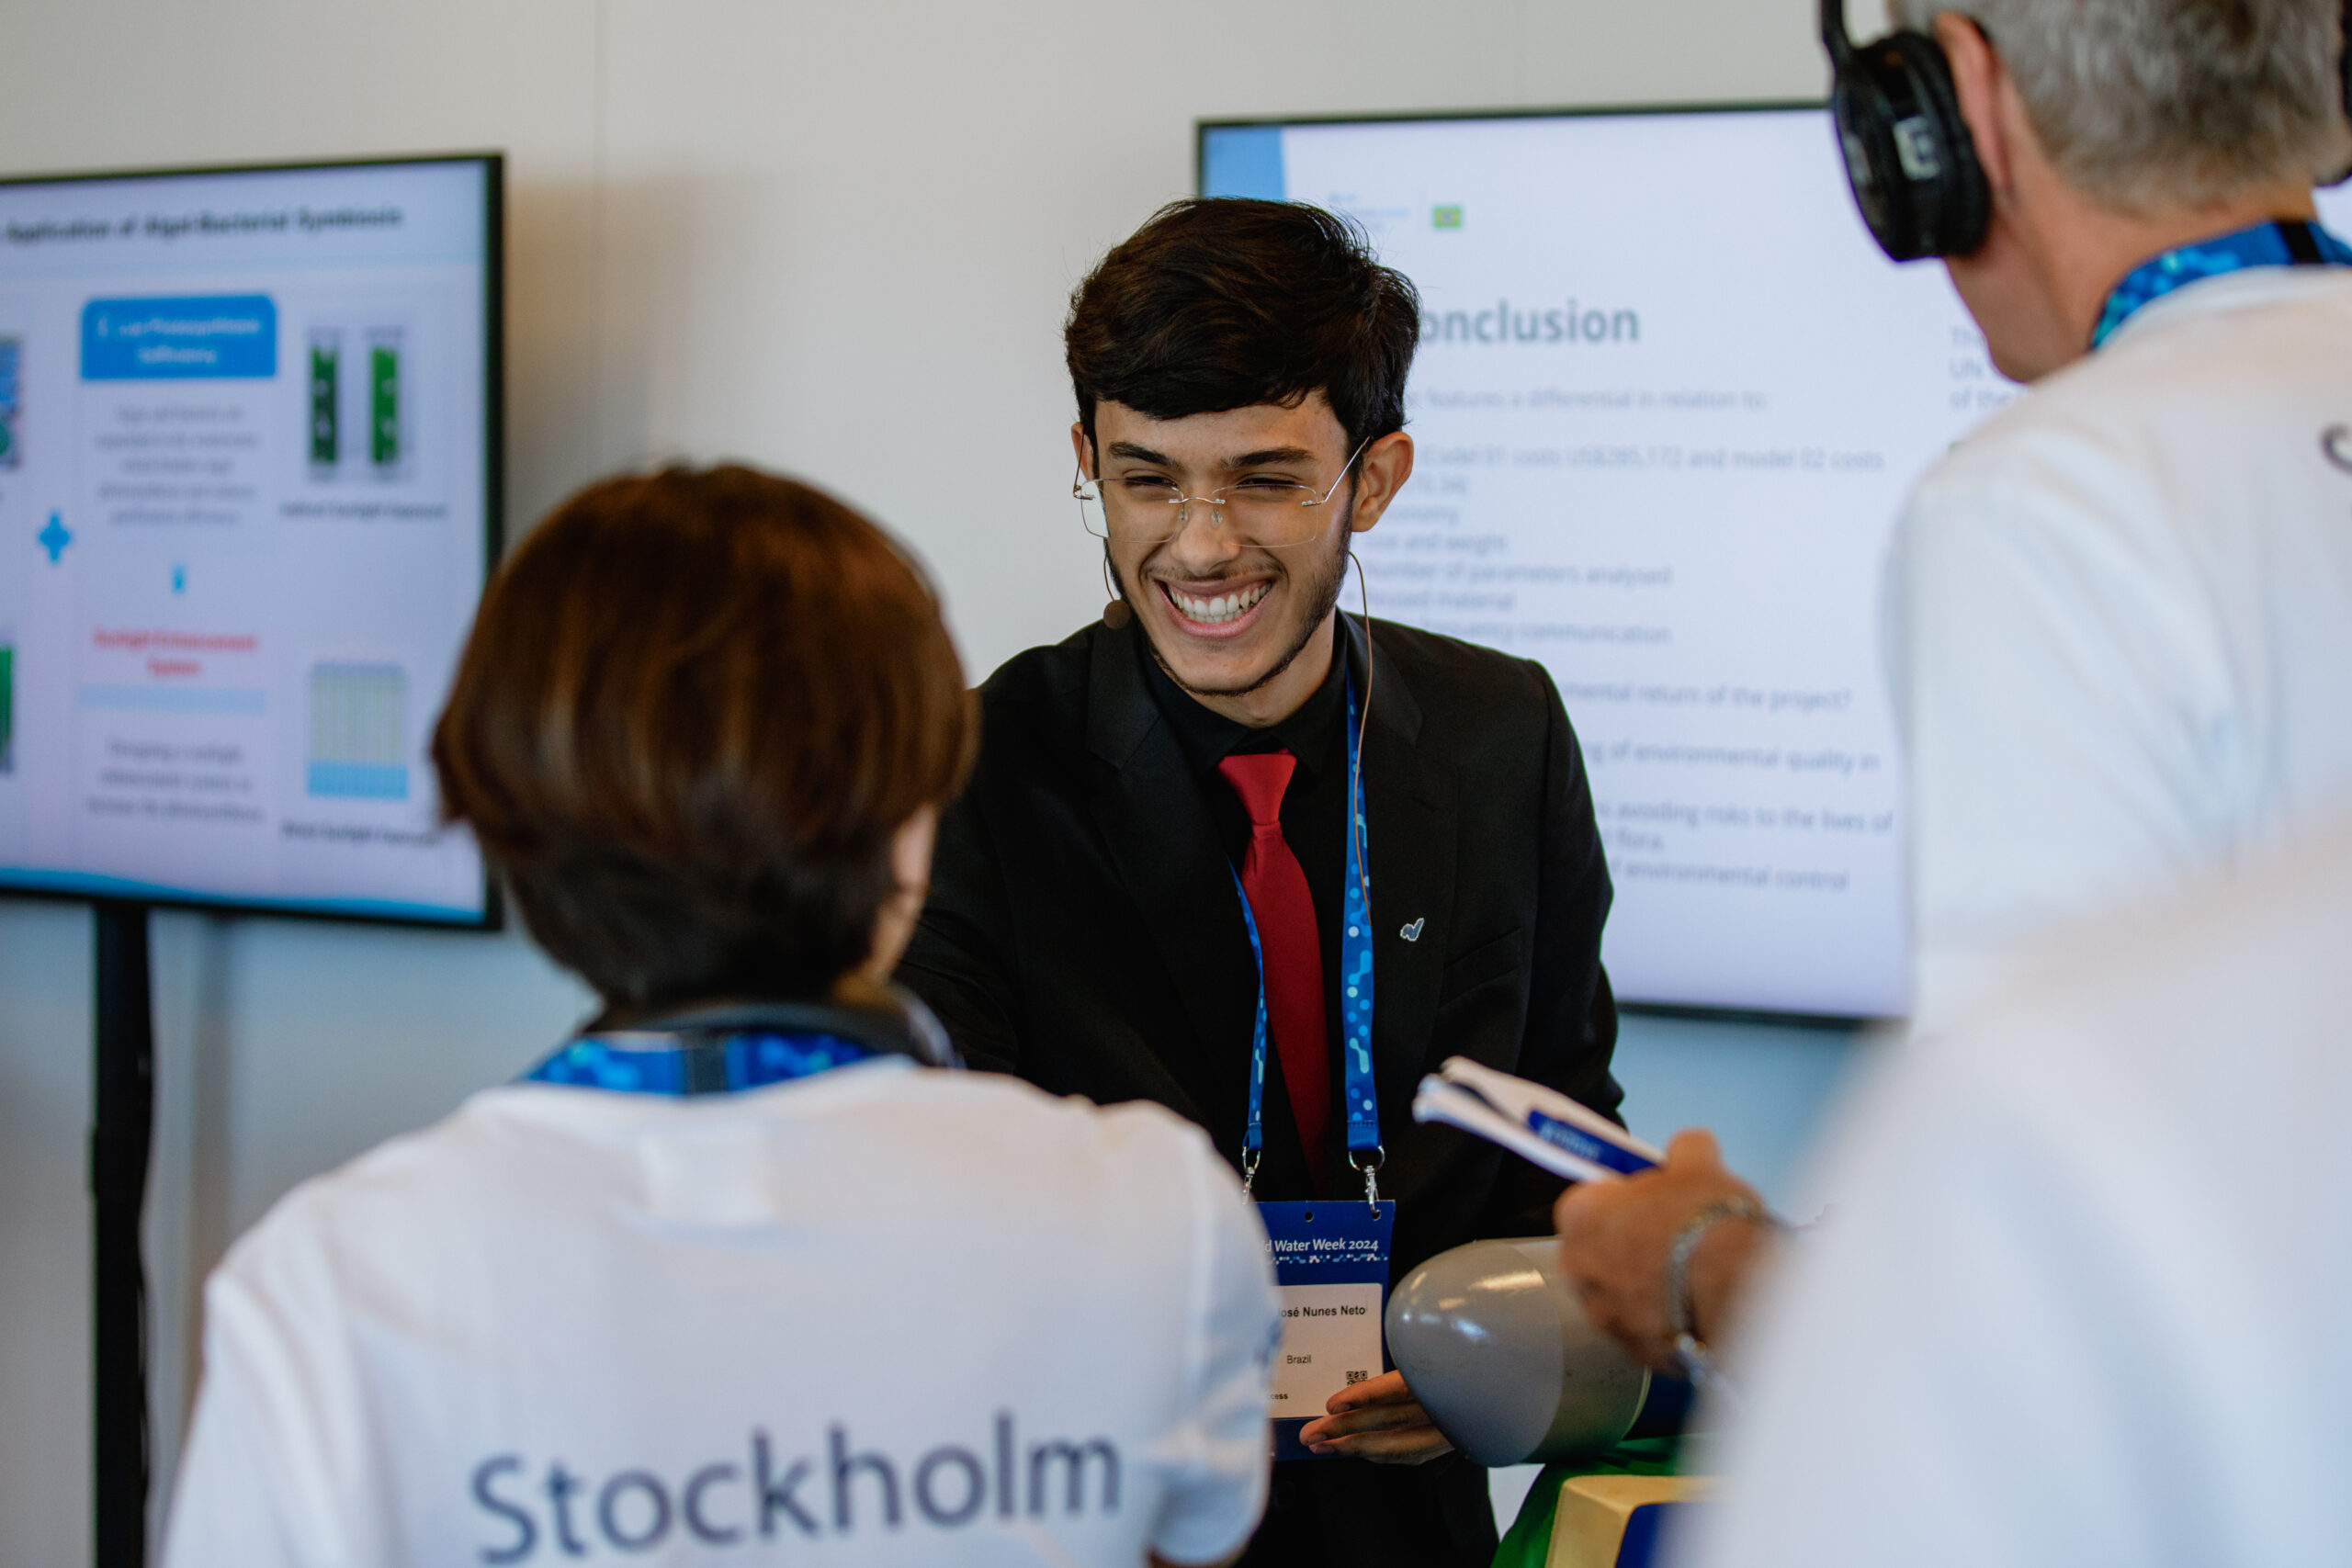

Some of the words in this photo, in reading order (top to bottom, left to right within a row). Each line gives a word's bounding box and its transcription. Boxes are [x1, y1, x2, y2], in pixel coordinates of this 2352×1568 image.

[1420, 298, 1639, 343] onclusion
[1689, 446, 1726, 468] and
[1406, 534, 1436, 549] and
[1445, 534, 1507, 556] weight
[1560, 682, 1631, 701] mental
[1708, 684, 1727, 704] of
[1733, 686, 1764, 705] the
[1635, 743, 1781, 769] environmental
[1782, 807, 1815, 829] the
[1626, 862, 1770, 886] environmental
[1274, 1239, 1310, 1252] Water
[1313, 1237, 1346, 1251] Week
[1348, 1240, 1379, 1251] 2024
[1279, 1307, 1299, 1317] osé
[1303, 1306, 1338, 1317] Nunes
[1340, 1304, 1366, 1316] Neto
[1286, 1354, 1312, 1364] Brazil
[470, 1409, 1122, 1566] Stockholm
